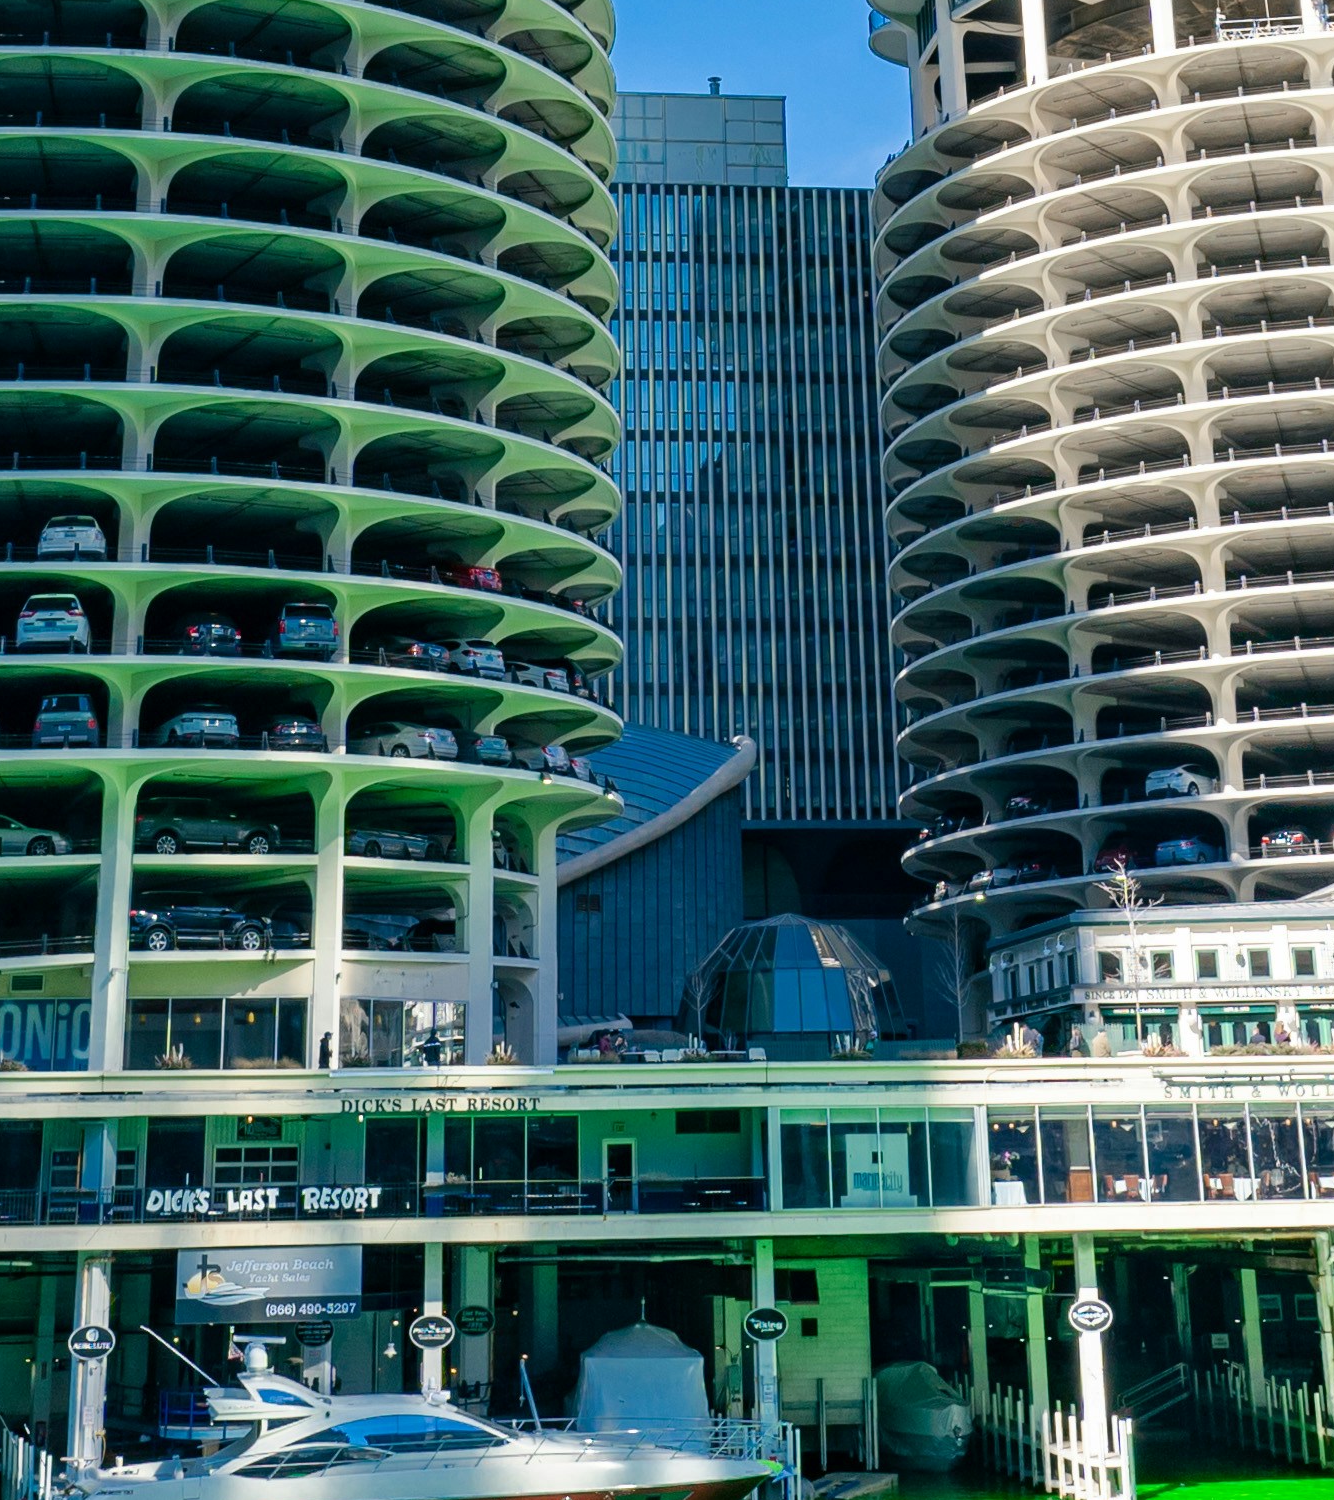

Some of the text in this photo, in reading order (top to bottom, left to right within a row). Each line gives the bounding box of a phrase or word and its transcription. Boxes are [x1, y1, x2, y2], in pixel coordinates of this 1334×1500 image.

[1085, 991, 1115, 1000] SINCE
[1147, 989, 1192, 1000] SMITH
[1199, 990, 1208, 999] &
[1215, 986, 1302, 999] WOLLENSKY
[1164, 1085, 1235, 1099] SMITH
[1252, 1085, 1262, 1098] &
[341, 1097, 541, 1112] DICK'S LAST RESORT
[146, 1187, 382, 1213] DICK'S LAST RESORT
[226, 1259, 334, 1274] Jefferson Beach
[249, 1273, 311, 1283] Yacht Sales
[266, 1303, 296, 1317] (866)
